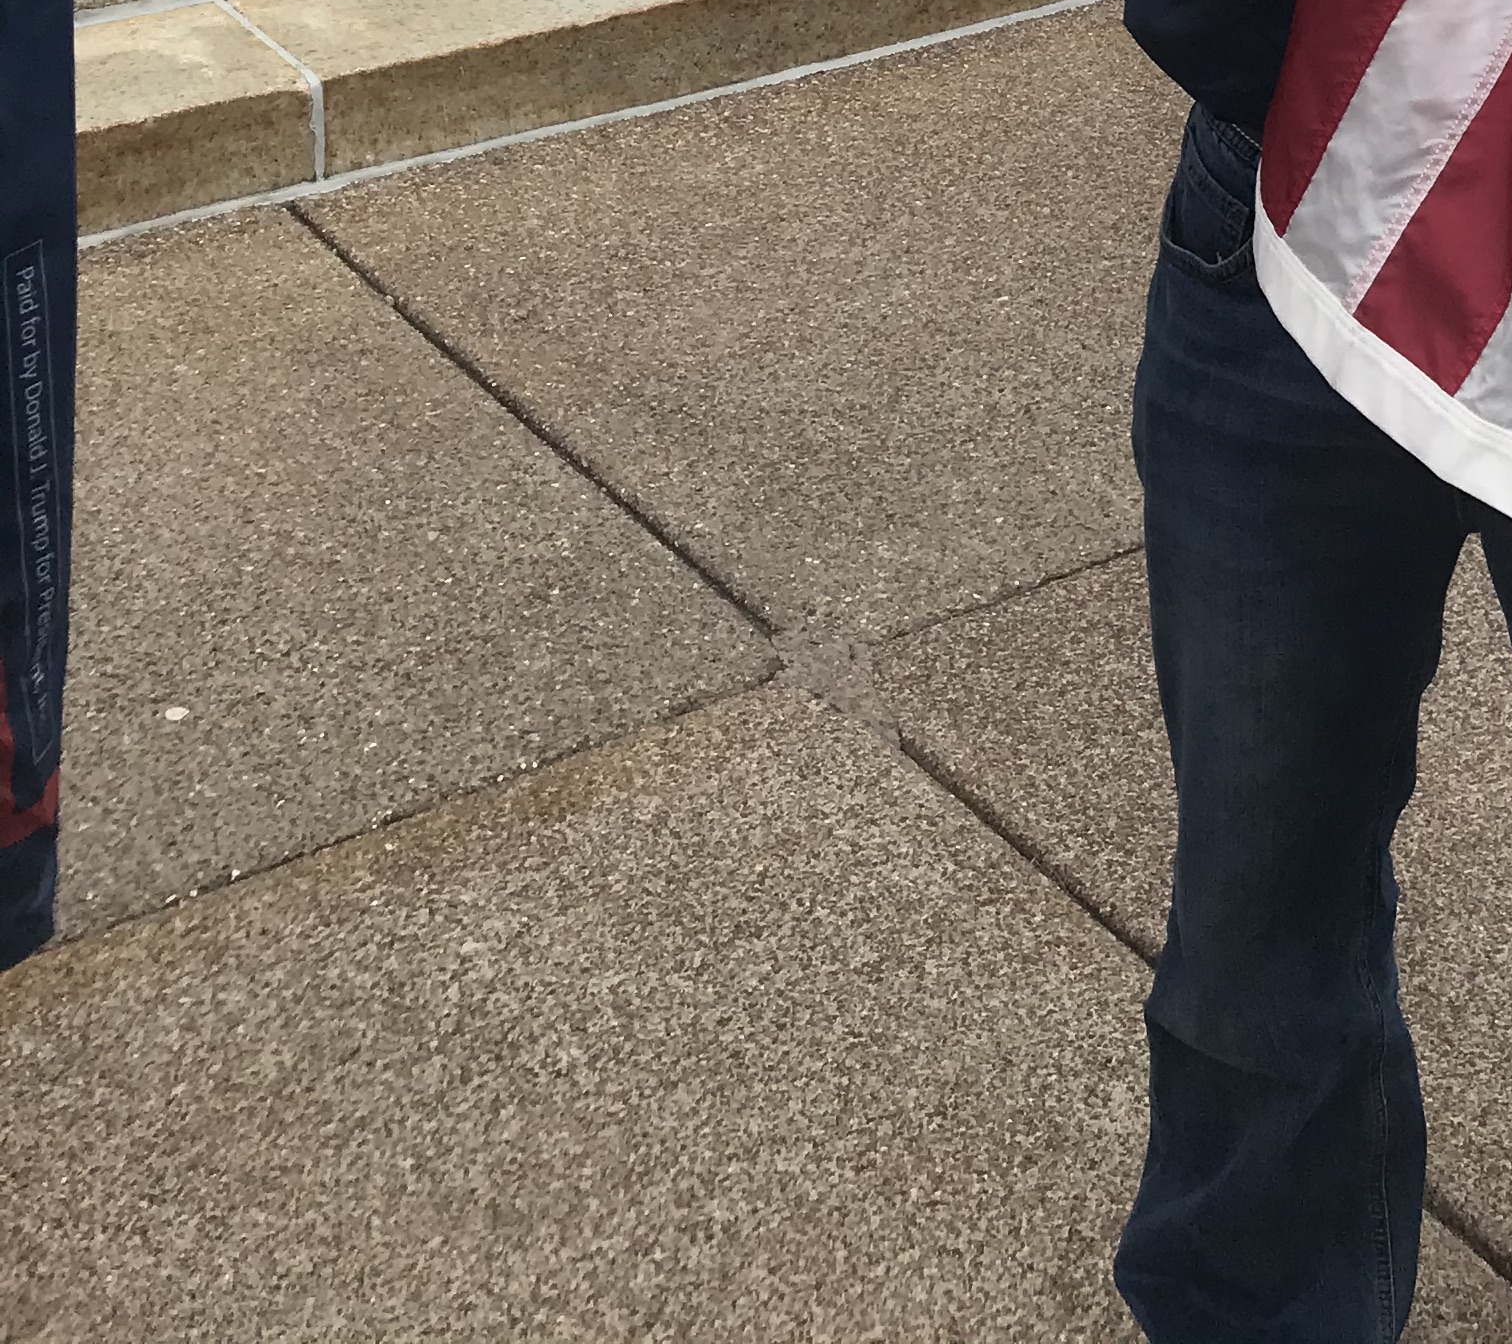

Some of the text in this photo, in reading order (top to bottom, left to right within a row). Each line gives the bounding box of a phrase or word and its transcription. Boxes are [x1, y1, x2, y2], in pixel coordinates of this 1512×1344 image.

[15, 264, 40, 315] Paid
[20, 315, 42, 347] for
[19, 350, 42, 380] by
[24, 381, 49, 462] Donald
[30, 480, 51, 552] Trump
[36, 552, 55, 585] for
